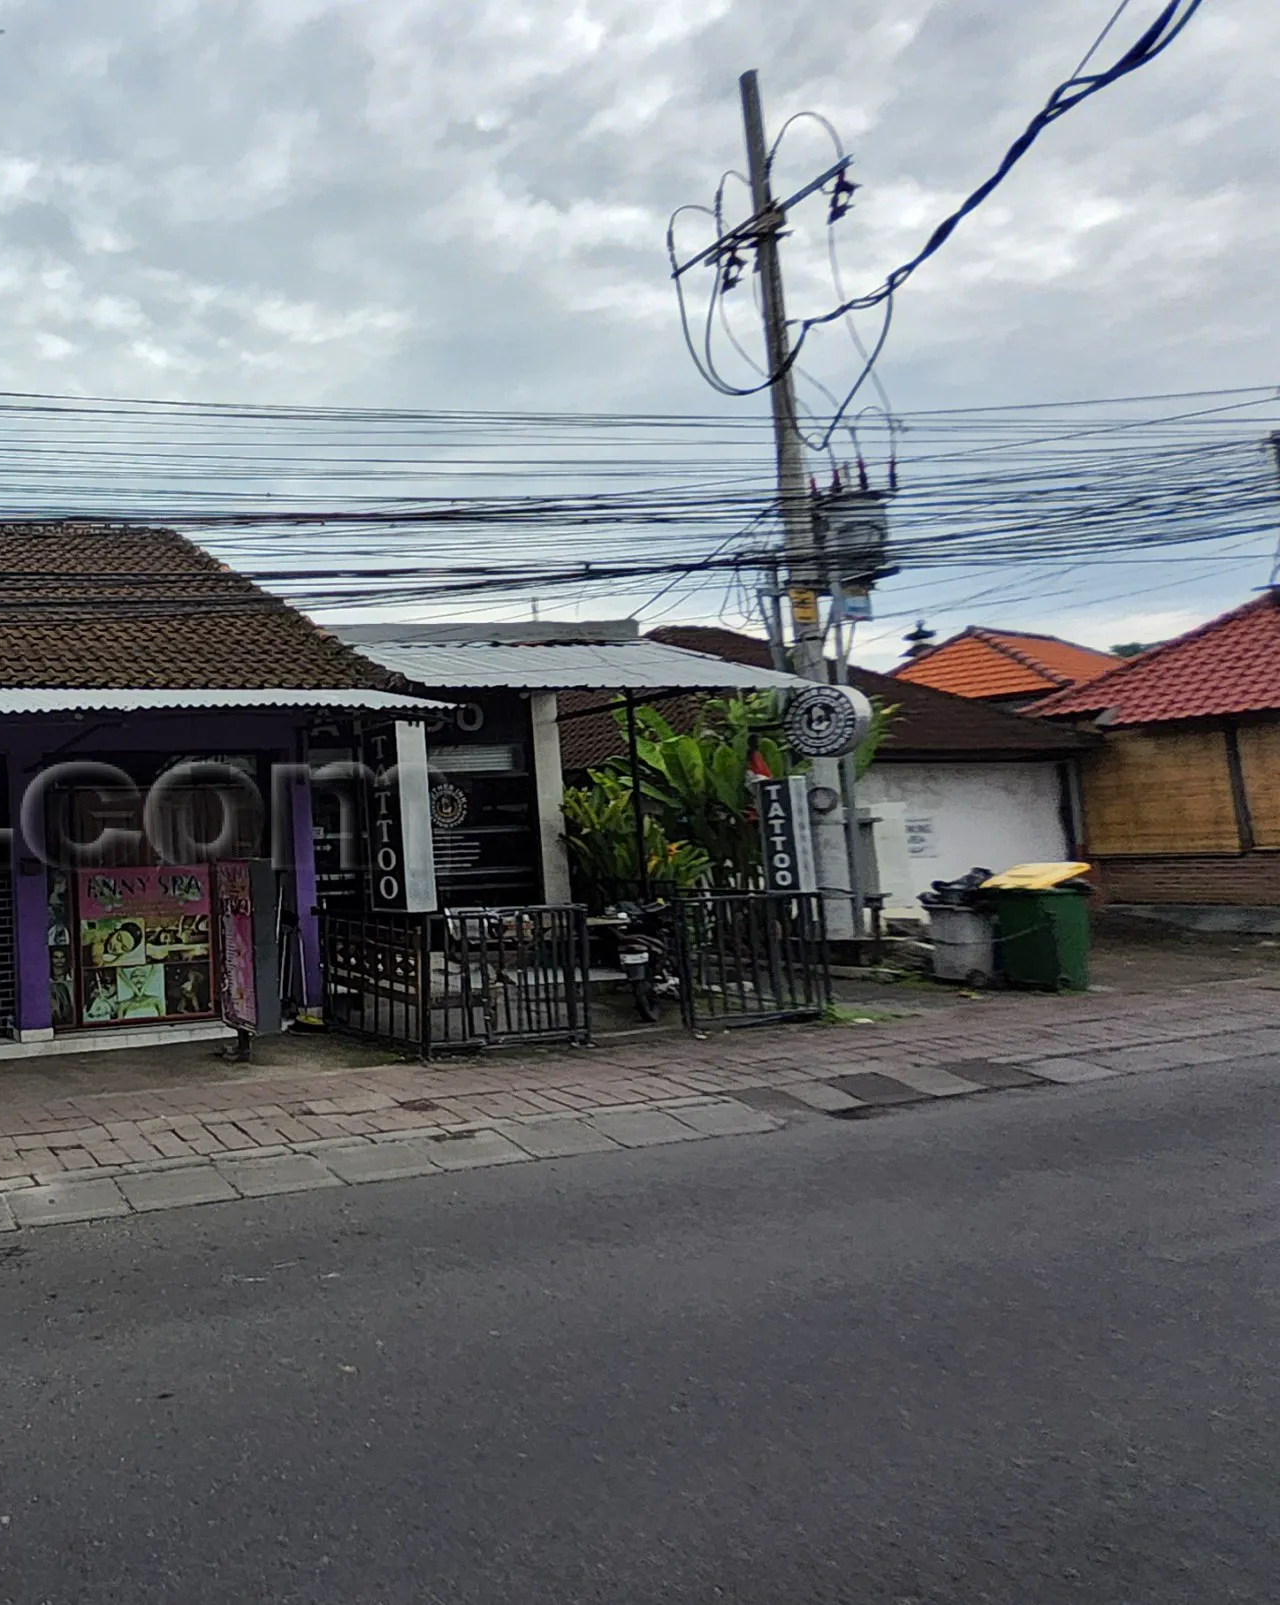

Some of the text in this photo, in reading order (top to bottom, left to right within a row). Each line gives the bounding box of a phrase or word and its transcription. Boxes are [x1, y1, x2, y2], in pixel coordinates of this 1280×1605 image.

[370, 735, 399, 900] TATTOO
[764, 784, 792, 886] TATTOO
[158, 875, 202, 897] SPA
